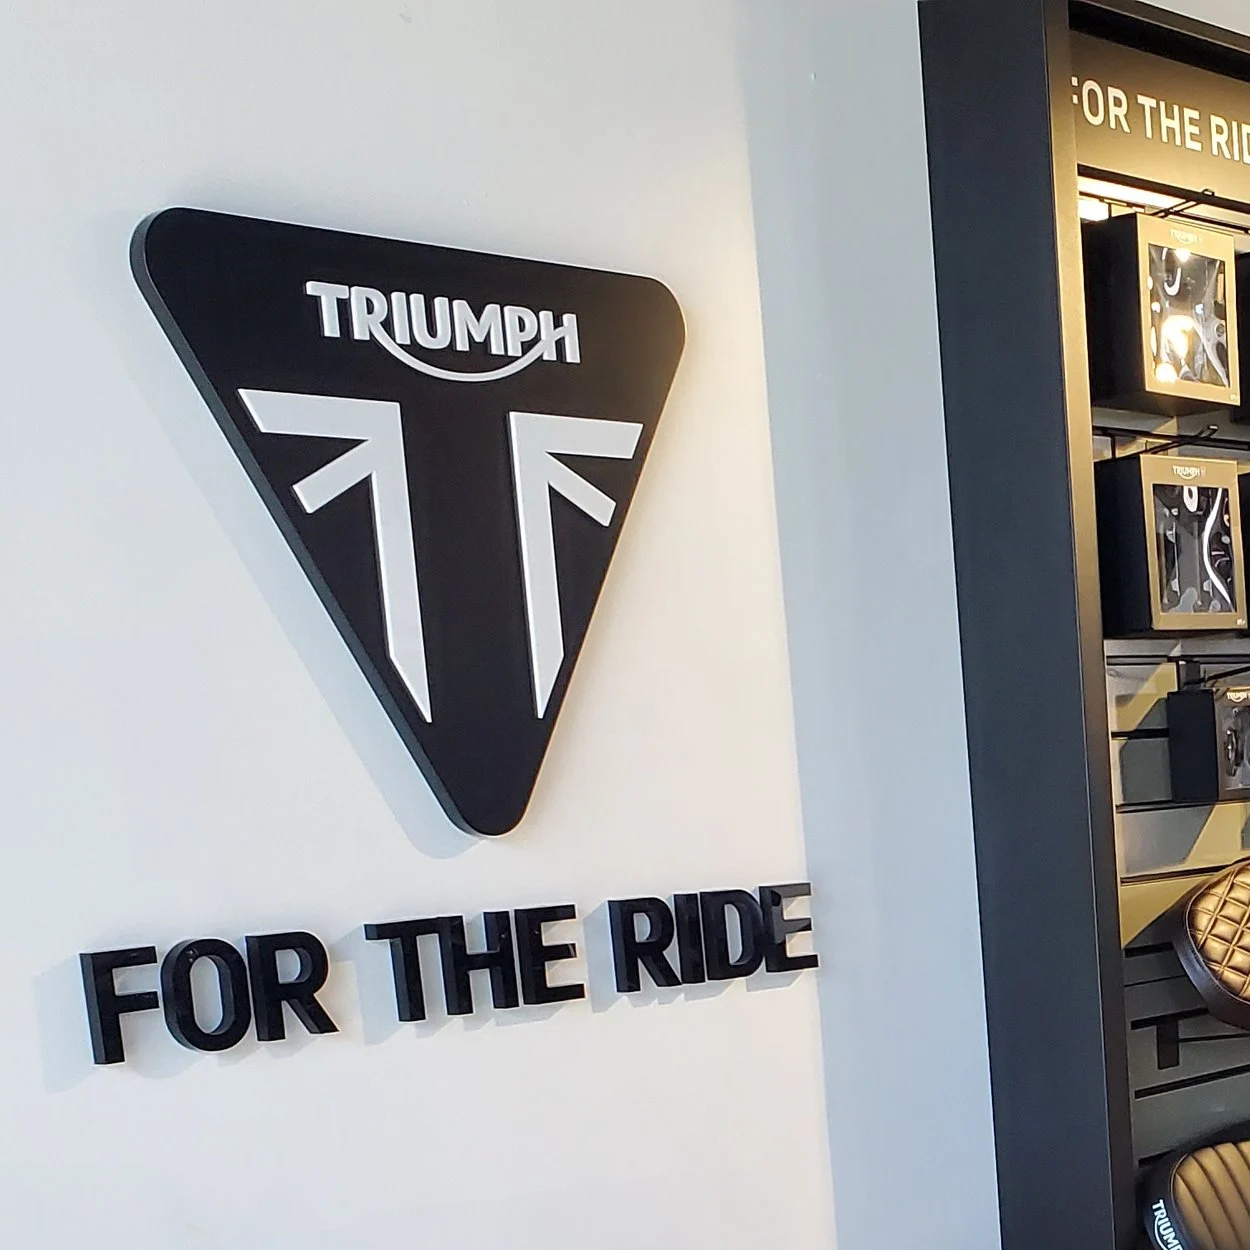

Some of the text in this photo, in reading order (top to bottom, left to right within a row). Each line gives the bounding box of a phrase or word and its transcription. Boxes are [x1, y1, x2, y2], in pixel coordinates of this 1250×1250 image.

[1137, 94, 1203, 152] THE
[305, 280, 581, 383] TRIUMPH
[79, 882, 820, 1066] FOR THE RIDE
